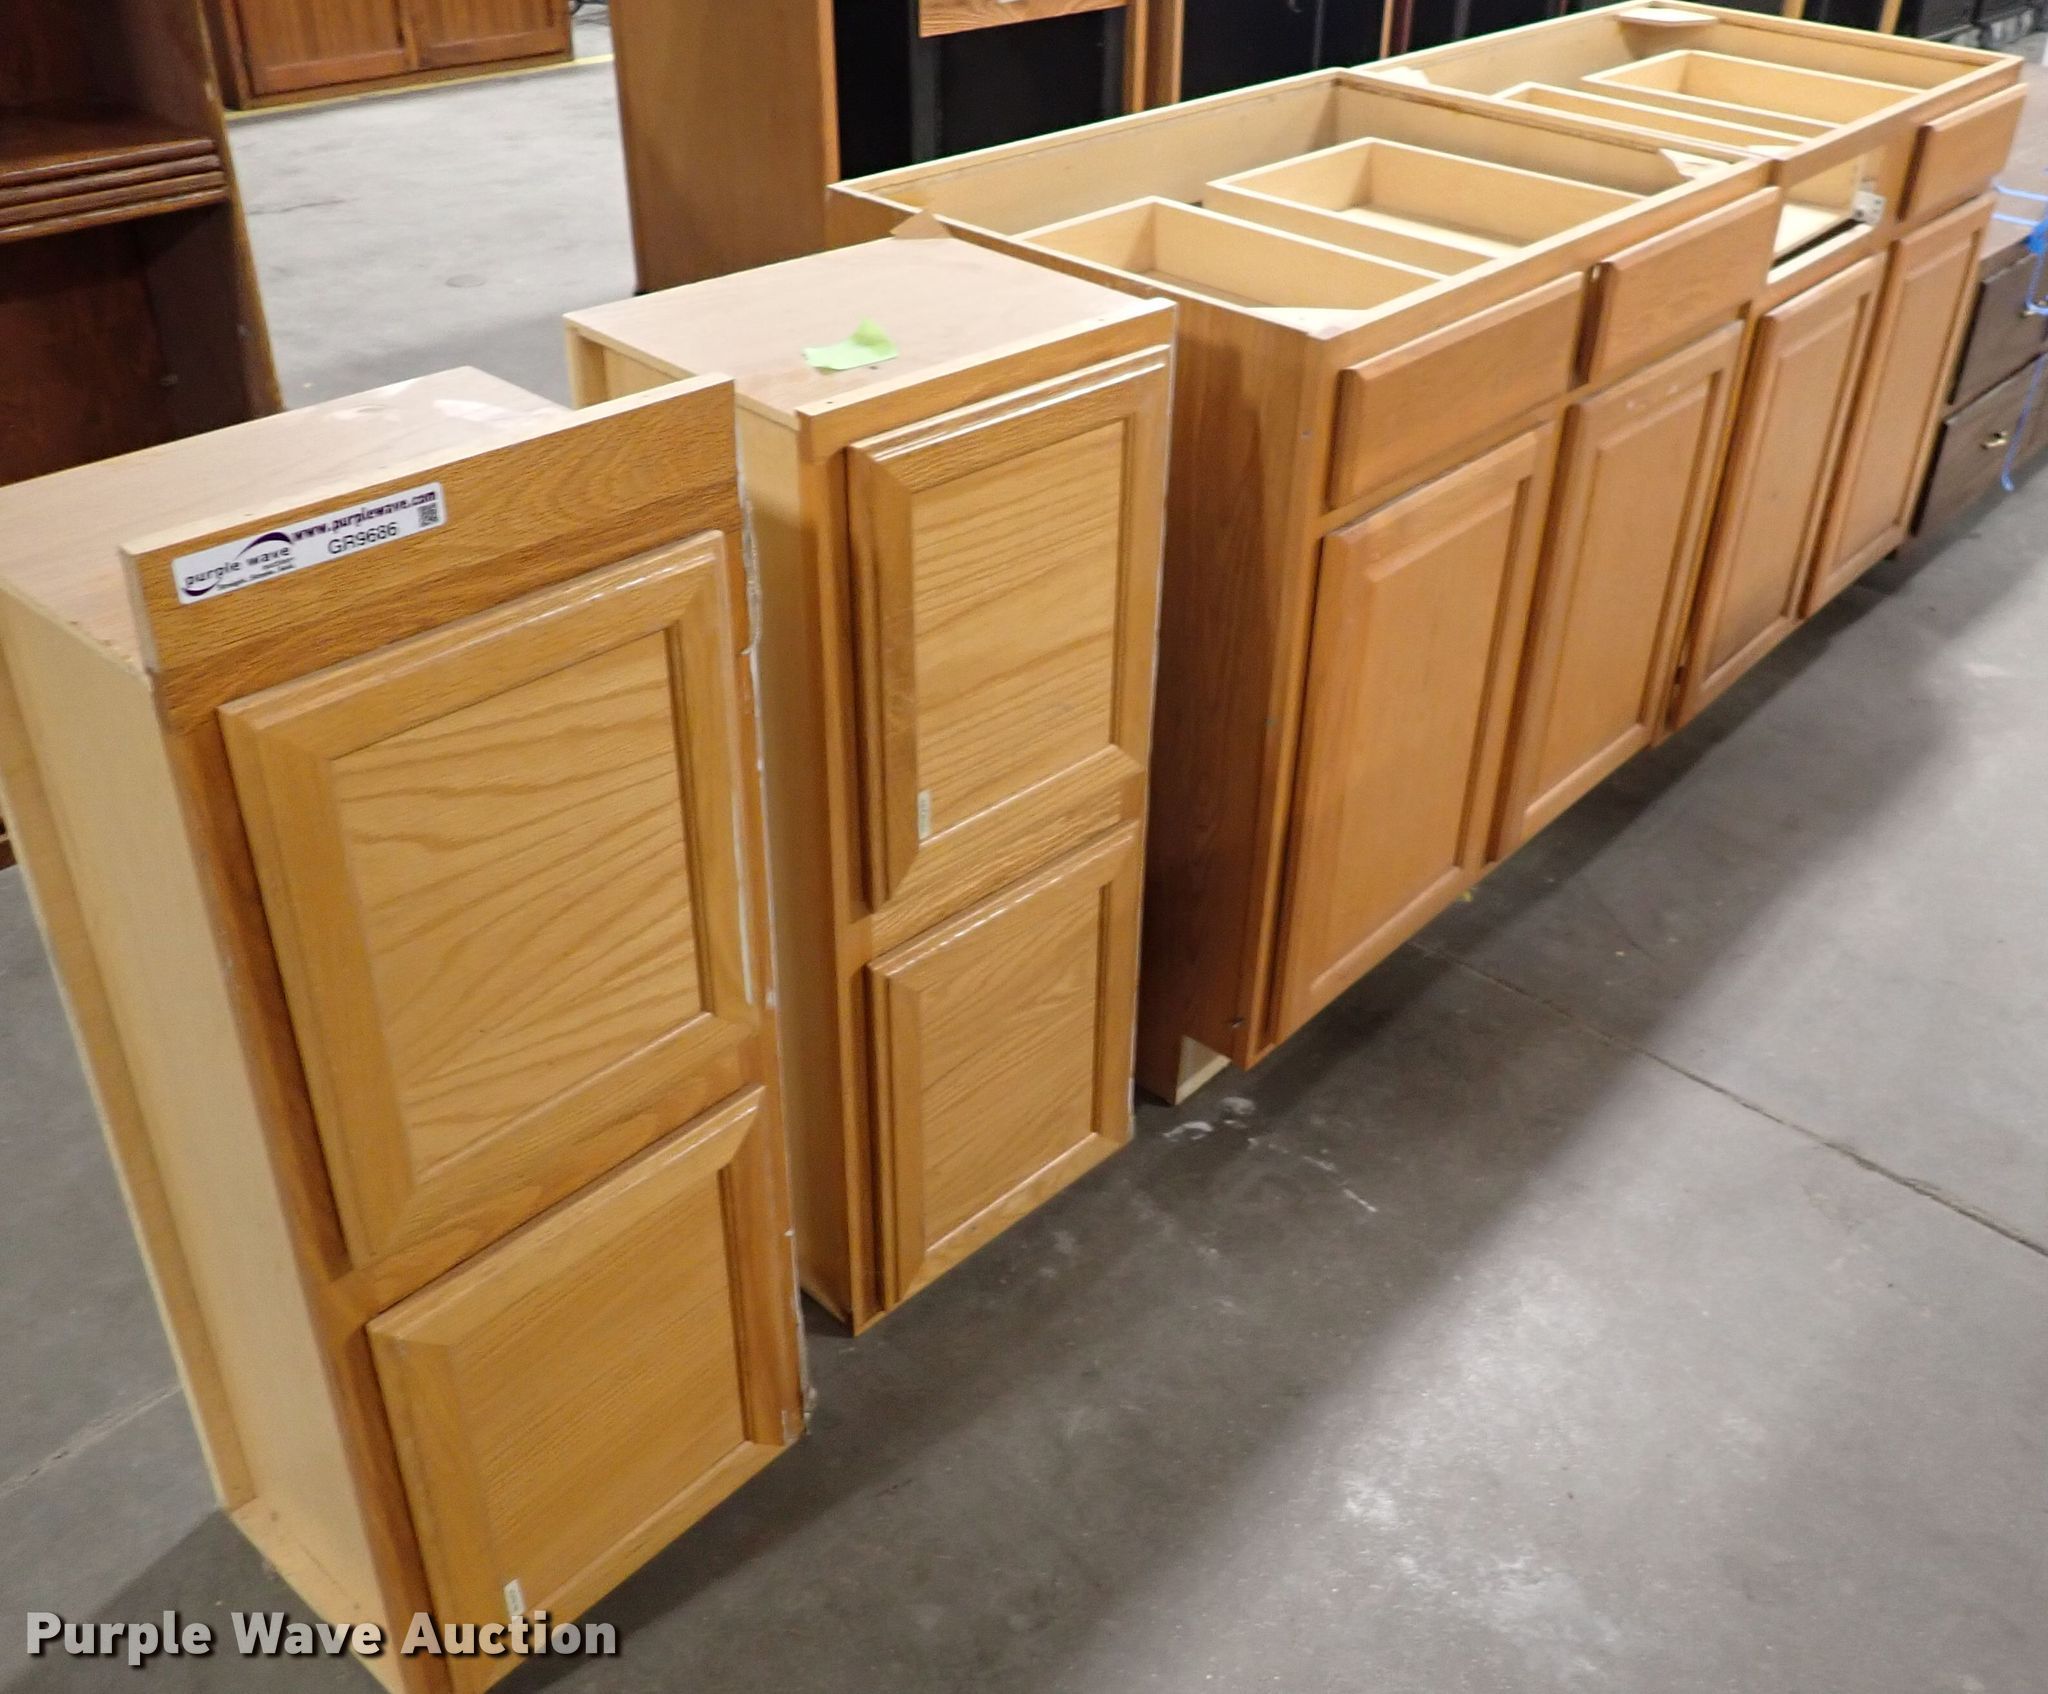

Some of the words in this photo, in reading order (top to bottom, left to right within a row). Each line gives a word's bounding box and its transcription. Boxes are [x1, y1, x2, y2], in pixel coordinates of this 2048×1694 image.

[292, 491, 436, 542] www.purplewave.com
[185, 559, 240, 587] purple
[246, 546, 290, 565] wave
